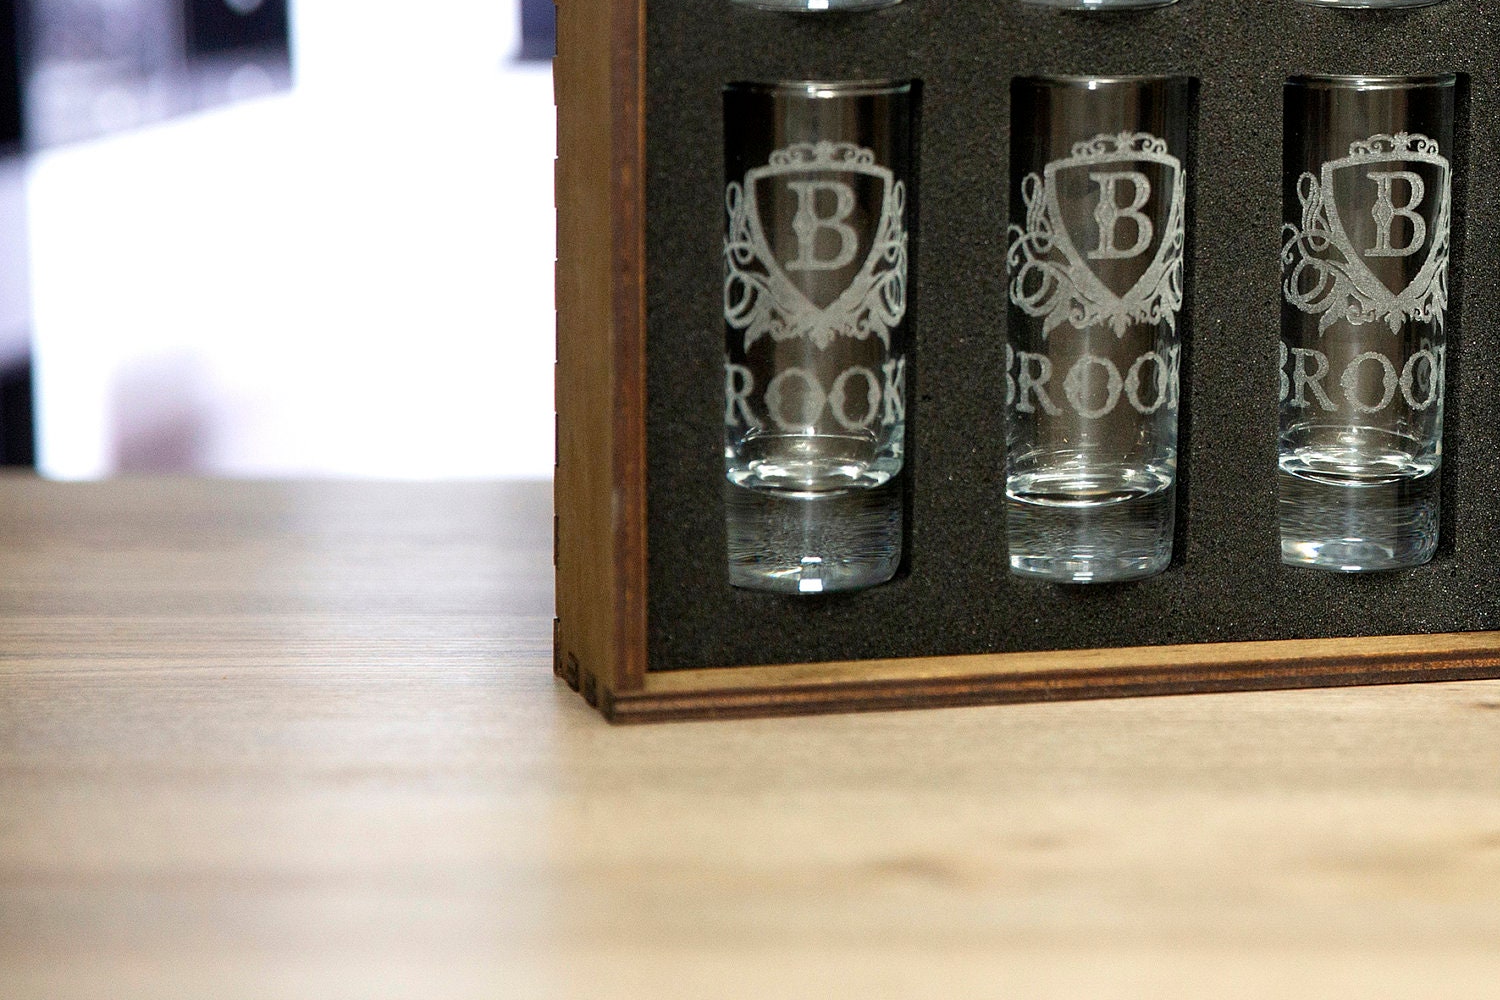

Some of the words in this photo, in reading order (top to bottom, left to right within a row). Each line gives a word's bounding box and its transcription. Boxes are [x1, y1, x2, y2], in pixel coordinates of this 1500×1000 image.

[783, 181, 858, 271] B
[1087, 171, 1153, 260] B
[1364, 171, 1427, 257] B
